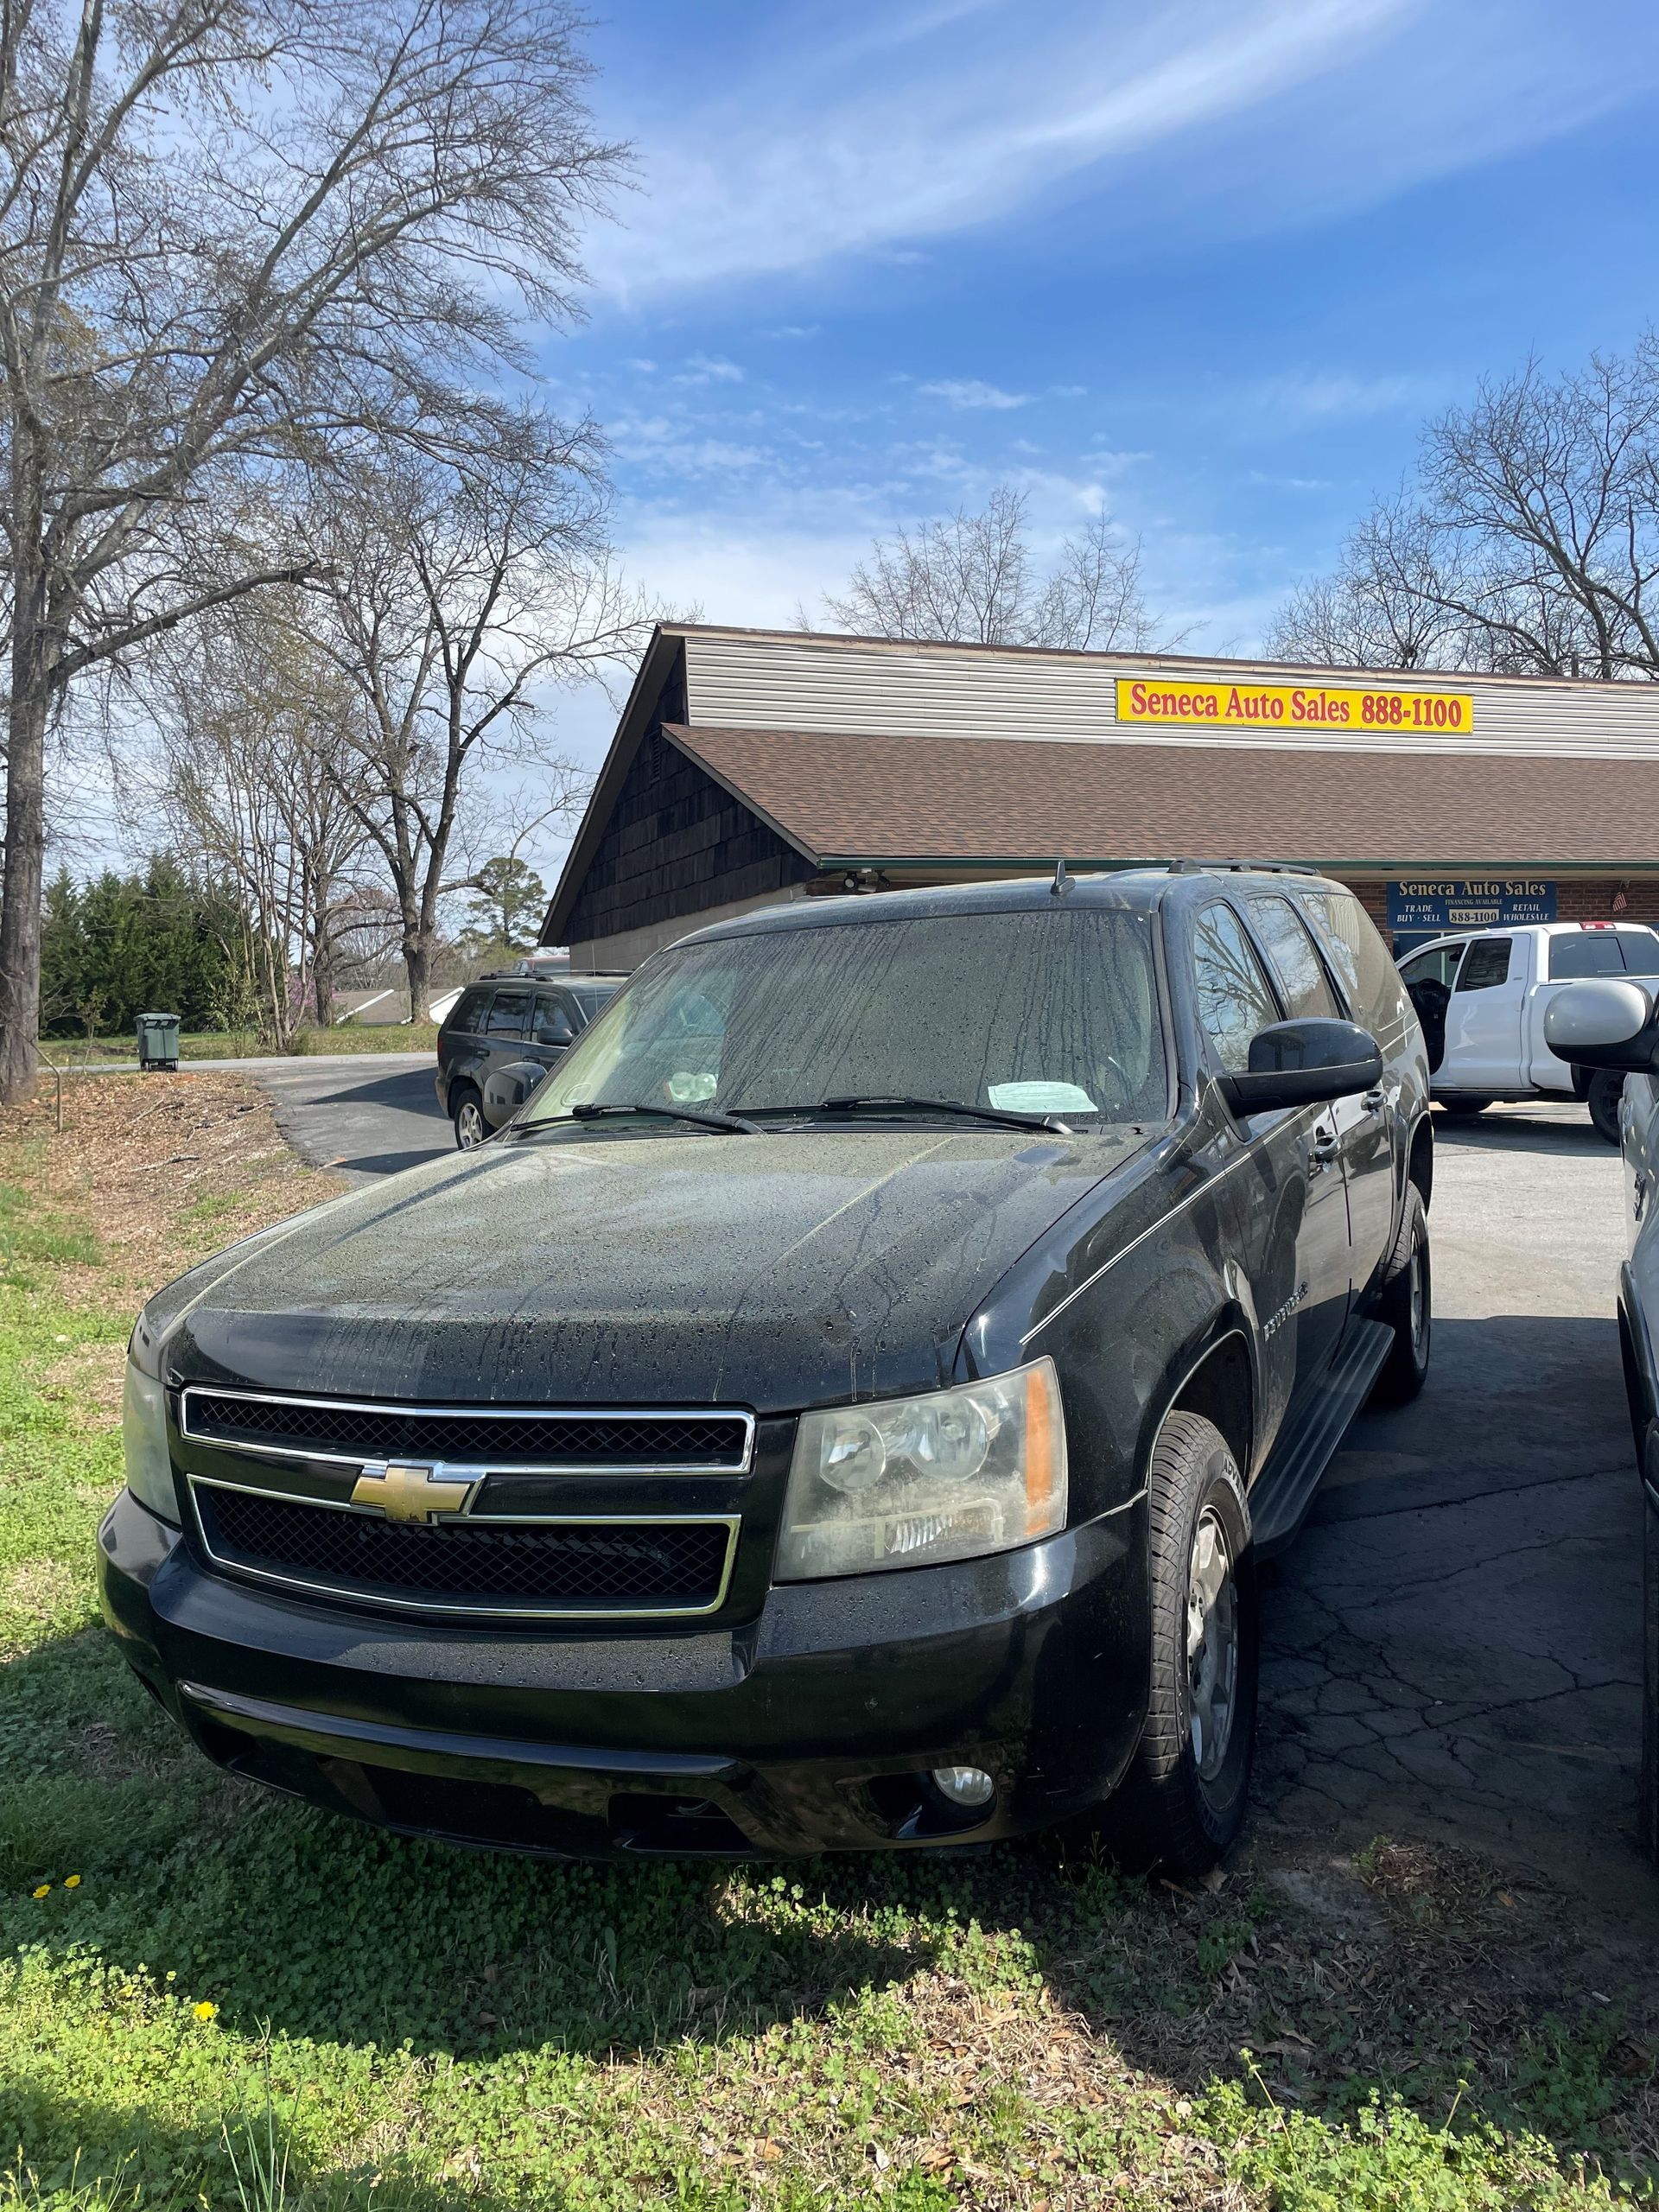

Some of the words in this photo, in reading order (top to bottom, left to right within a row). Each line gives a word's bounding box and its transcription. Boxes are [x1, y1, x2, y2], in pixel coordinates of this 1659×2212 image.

[1131, 683, 1218, 717] Seneca
[1225, 688, 1284, 720] Auto
[1292, 690, 1350, 722] Sales
[1362, 695, 1462, 727] 888-1100
[1399, 880, 1455, 896] Seneca
[1461, 880, 1500, 896] Auto
[1505, 880, 1546, 896] Sales
[1404, 904, 1433, 912] TRADE
[1451, 912, 1497, 922] 888-1100
[1503, 912, 1549, 921] WHOLESALE
